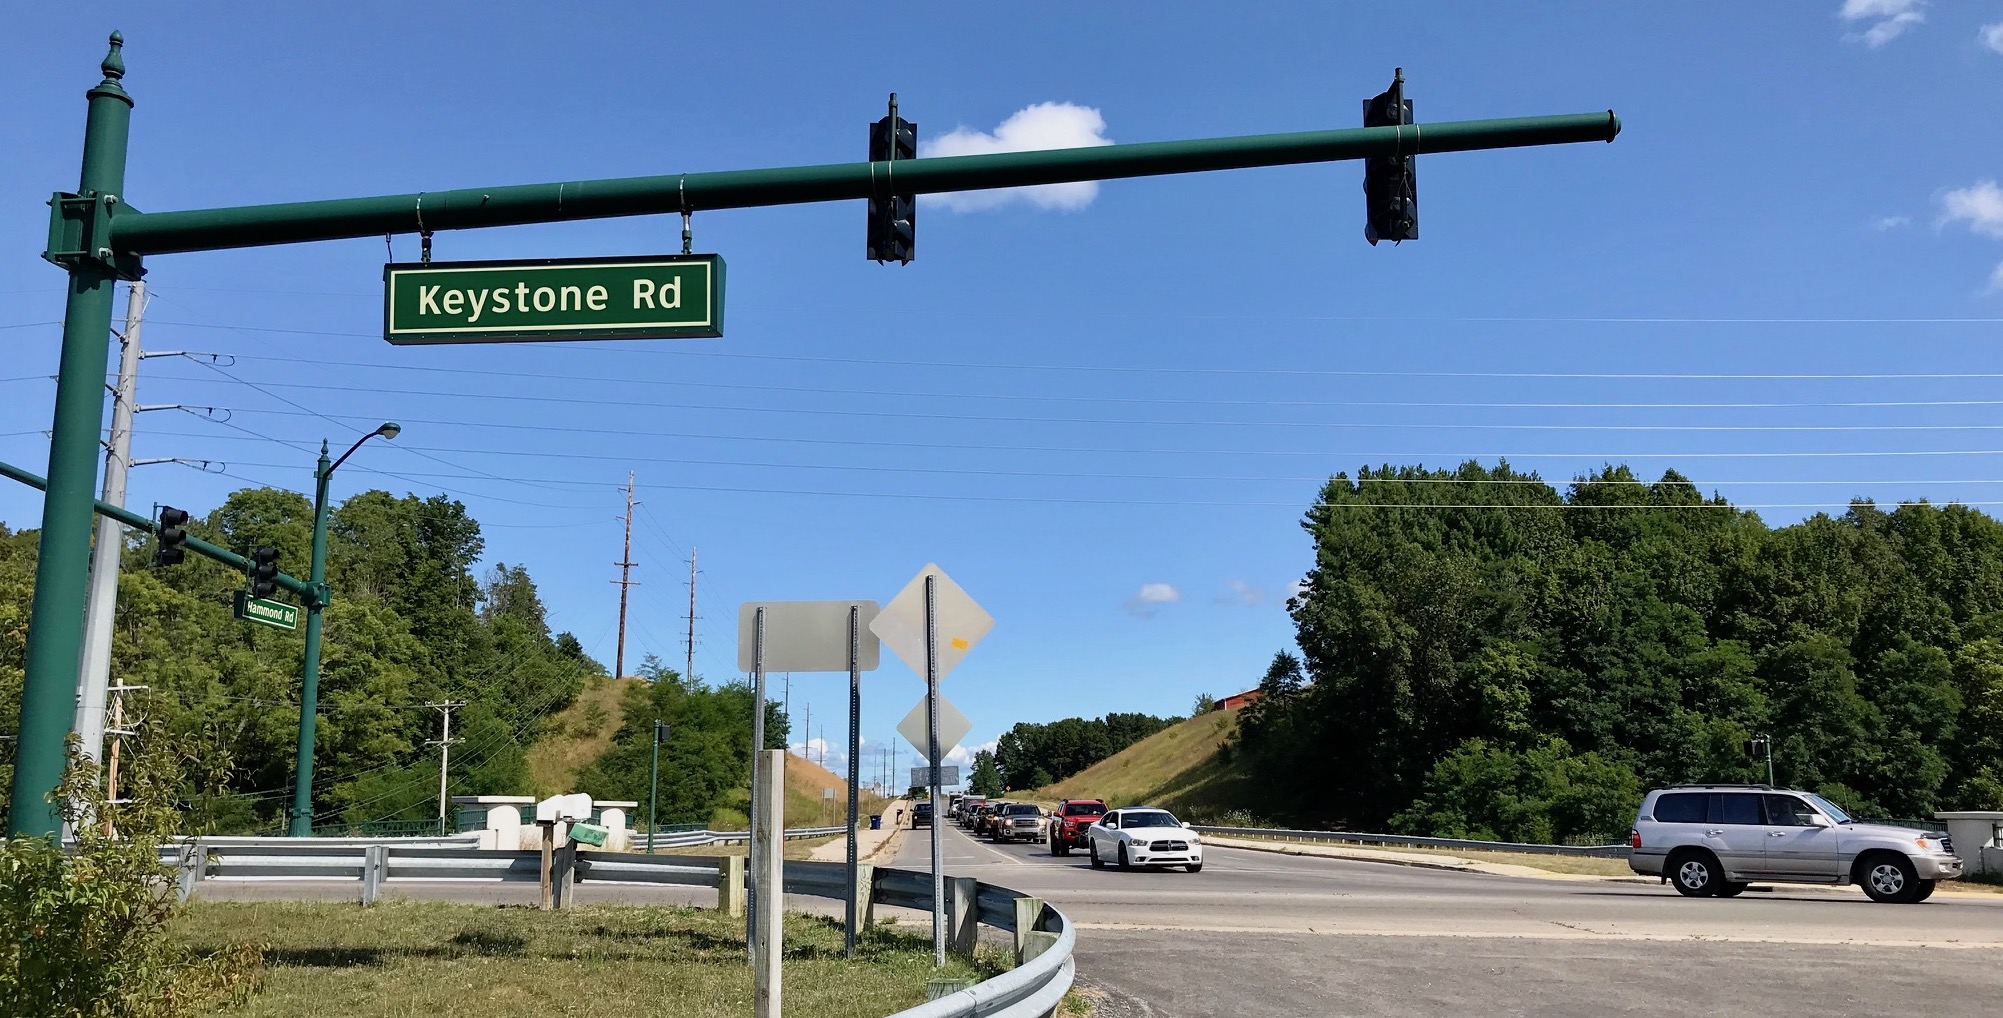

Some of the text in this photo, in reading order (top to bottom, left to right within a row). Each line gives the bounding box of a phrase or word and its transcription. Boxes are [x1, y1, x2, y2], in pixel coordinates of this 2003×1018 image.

[418, 275, 682, 323] Keystone Rd
[246, 600, 295, 623] Hammond Rd
